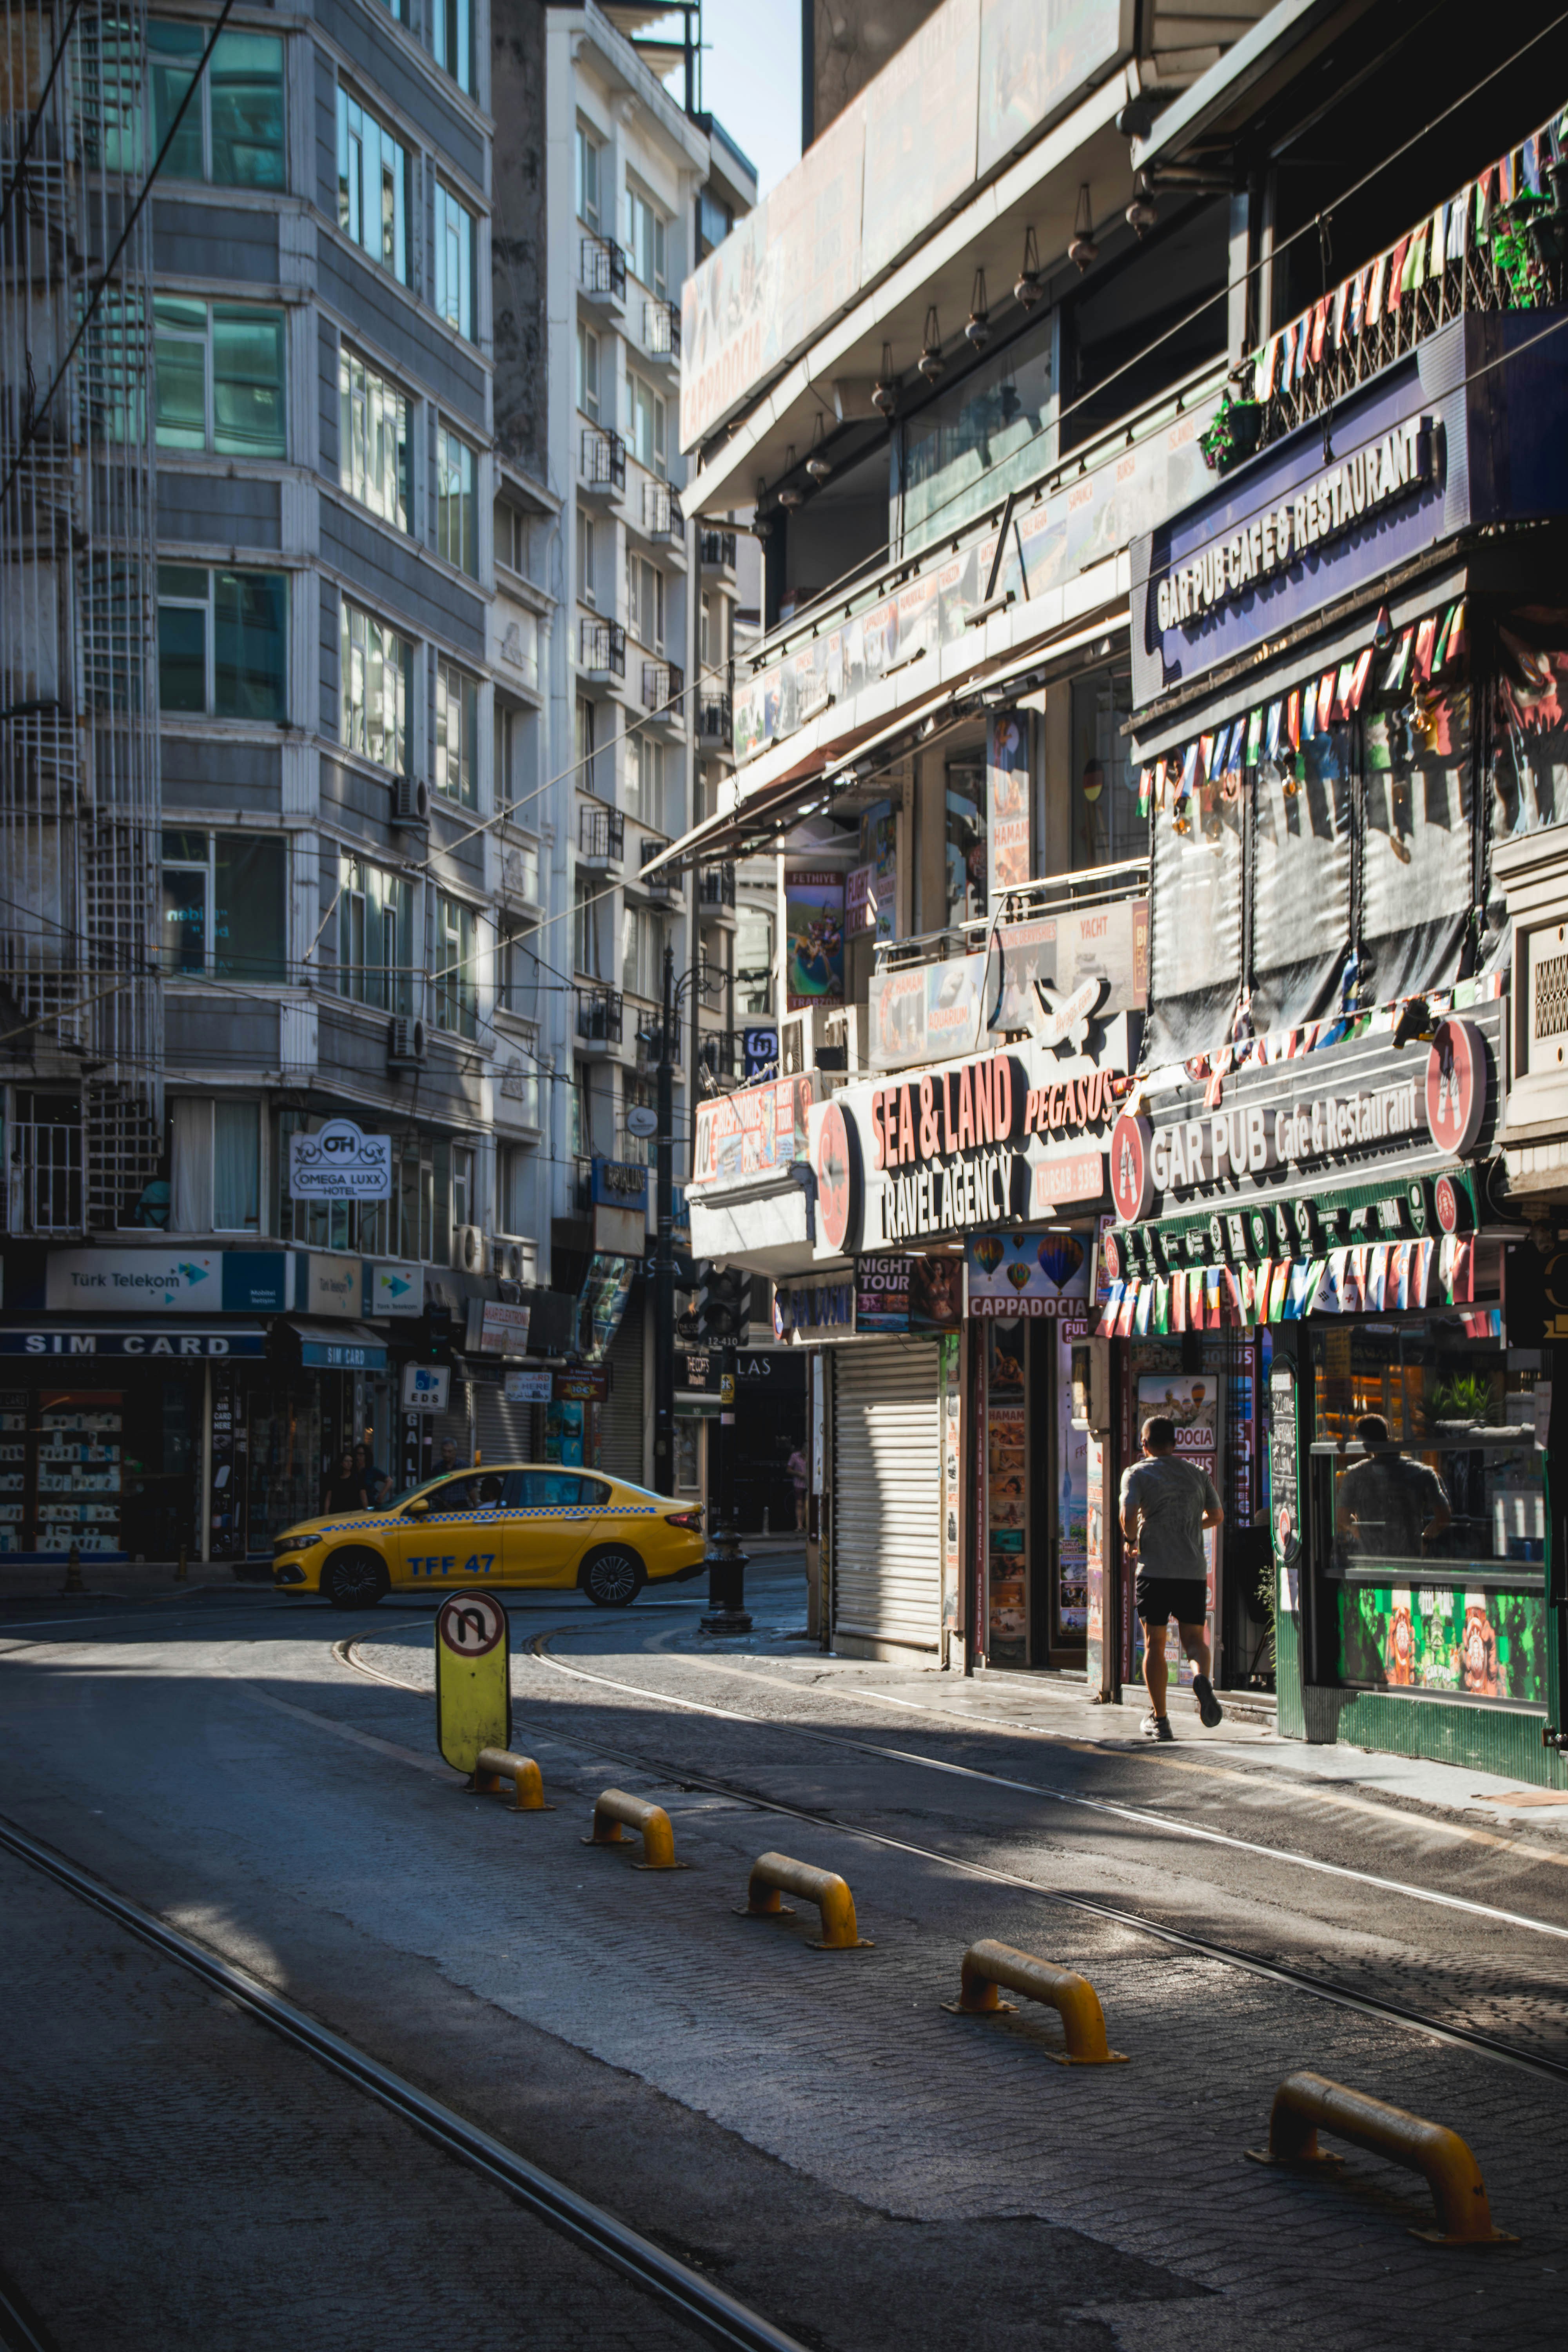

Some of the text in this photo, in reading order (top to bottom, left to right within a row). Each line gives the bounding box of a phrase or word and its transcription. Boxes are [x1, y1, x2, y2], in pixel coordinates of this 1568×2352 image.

[684, 319, 761, 443] CAPPADOCIA
[1157, 416, 1422, 632] GAR PUB CAFE & RESTAURANT
[994, 820, 1029, 847] HAMAM
[793, 873, 836, 884] FETHIYE
[848, 867, 869, 905] FLIGHT
[1080, 915, 1108, 940] YACHT
[895, 973, 923, 994] HAMAM
[928, 1006, 968, 1030] AQUARIUM
[776, 1081, 793, 1107] NIGHT
[1024, 1067, 1114, 1136] PEGASUS
[718, 1091, 761, 1135] BOSPHORUS
[776, 1106, 792, 1131] TOUR
[872, 1054, 1011, 1171] SEA & LAND
[1150, 1120, 1206, 1191] GAR
[1210, 1106, 1266, 1179] PUB
[1274, 1102, 1309, 1162] Cafe
[1311, 1100, 1324, 1153] &
[1325, 1085, 1418, 1151] Restaurant
[300, 1174, 381, 1185] OMEGA LUXX
[1077, 1161, 1101, 1193] 9362
[323, 1187, 358, 1196] HOTEL
[877, 1153, 1012, 1239] TRAVEL AGENCY
[857, 1258, 914, 1274] NIGHT
[71, 1272, 180, 1288] Türk Telekom
[860, 1275, 909, 1291] TOUR
[970, 1298, 1087, 1317] CAPPADOCIA
[25, 1335, 230, 1355] SIM CARD
[708, 1336, 738, 1346] 12-410
[327, 1347, 365, 1365] SIM CARD
[411, 1393, 439, 1403] EDS
[571, 1385, 590, 1394] 10€
[214, 1412, 232, 1421] CARD
[214, 1421, 232, 1430] HERE
[989, 1410, 1024, 1421] HAMAM
[407, 1554, 495, 1575] TFF 47
